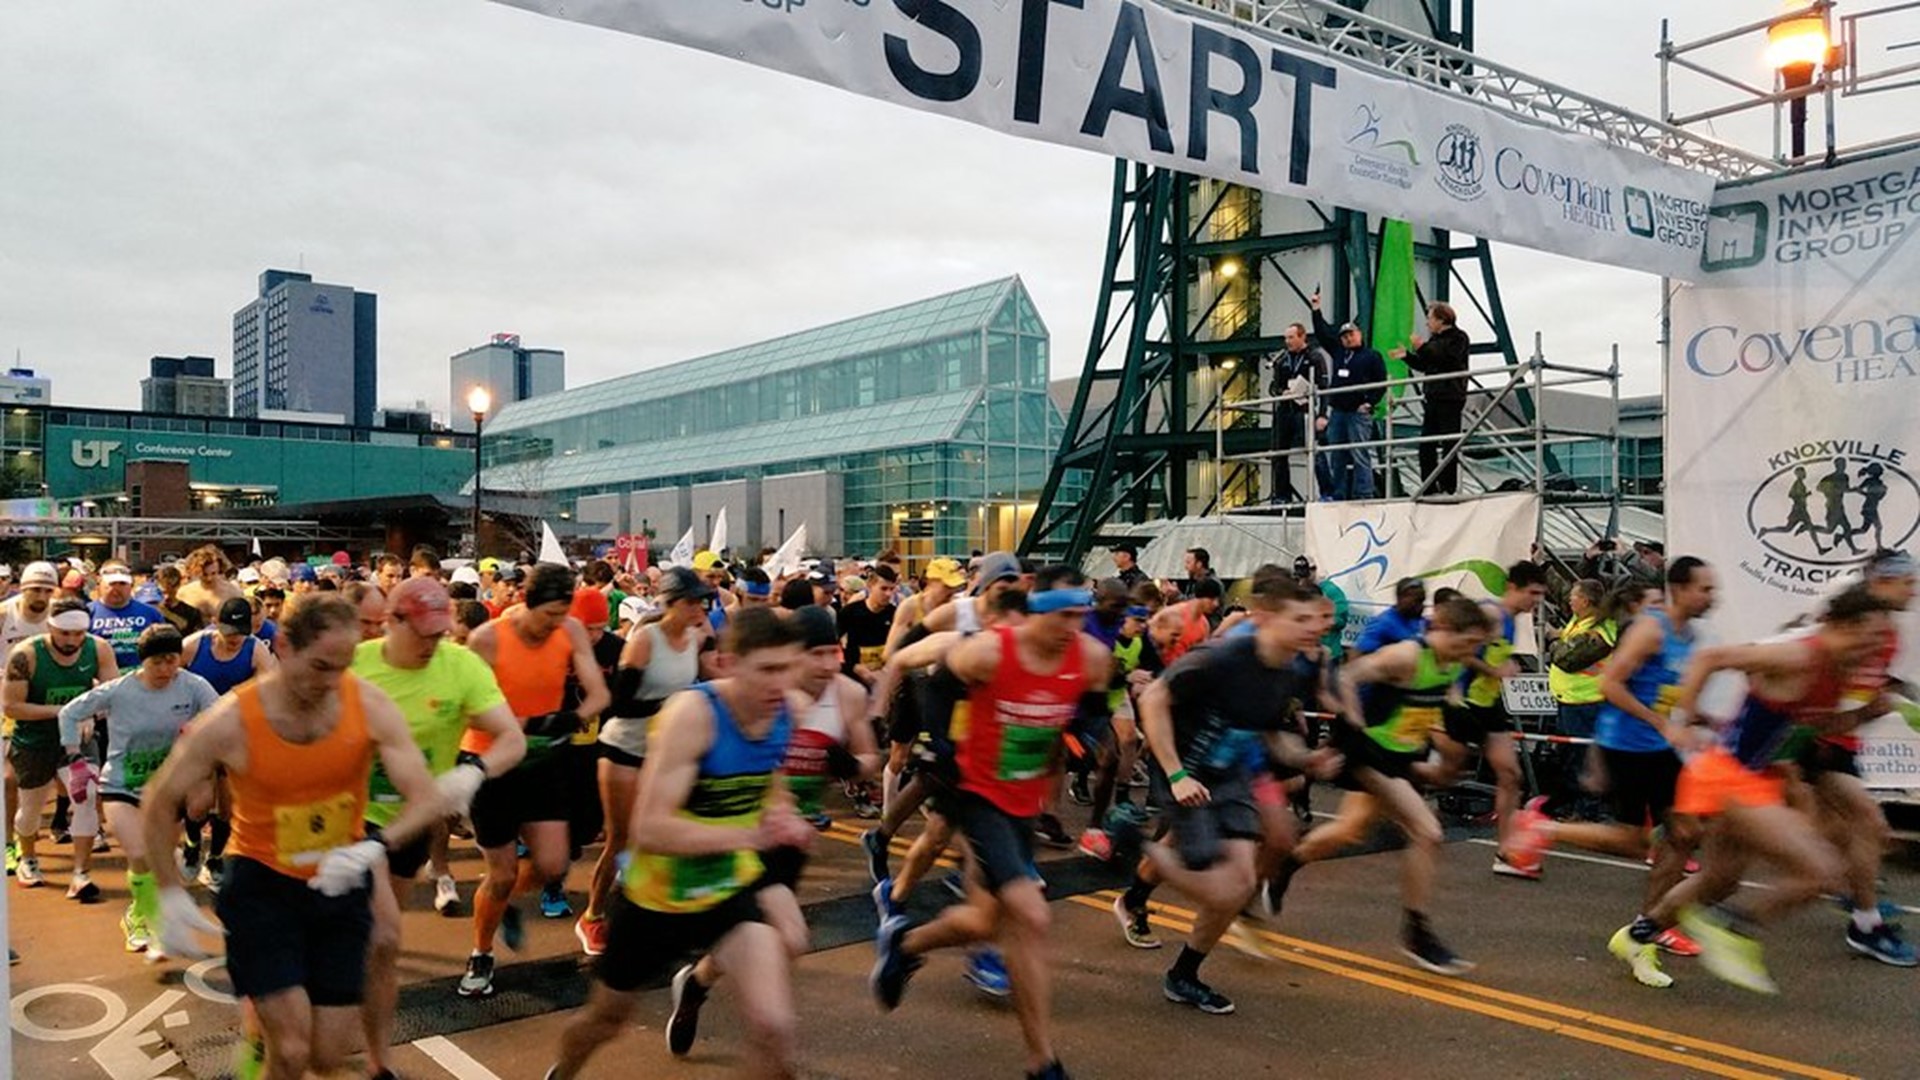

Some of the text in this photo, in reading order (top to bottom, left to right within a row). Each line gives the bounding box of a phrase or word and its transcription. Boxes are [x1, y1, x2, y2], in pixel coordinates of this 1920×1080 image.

[884, 0, 1338, 187] START
[1495, 146, 1612, 215] Covenant
[1562, 201, 1616, 232] HEALTH
[1657, 226, 1700, 249] GROUP
[1775, 222, 1906, 263] GROUP
[1686, 314, 1920, 377] Covena
[72, 439, 232, 468] UT Conference Center
[1768, 440, 1907, 471] KNOXVILLE
[92, 615, 146, 630] DENSO
